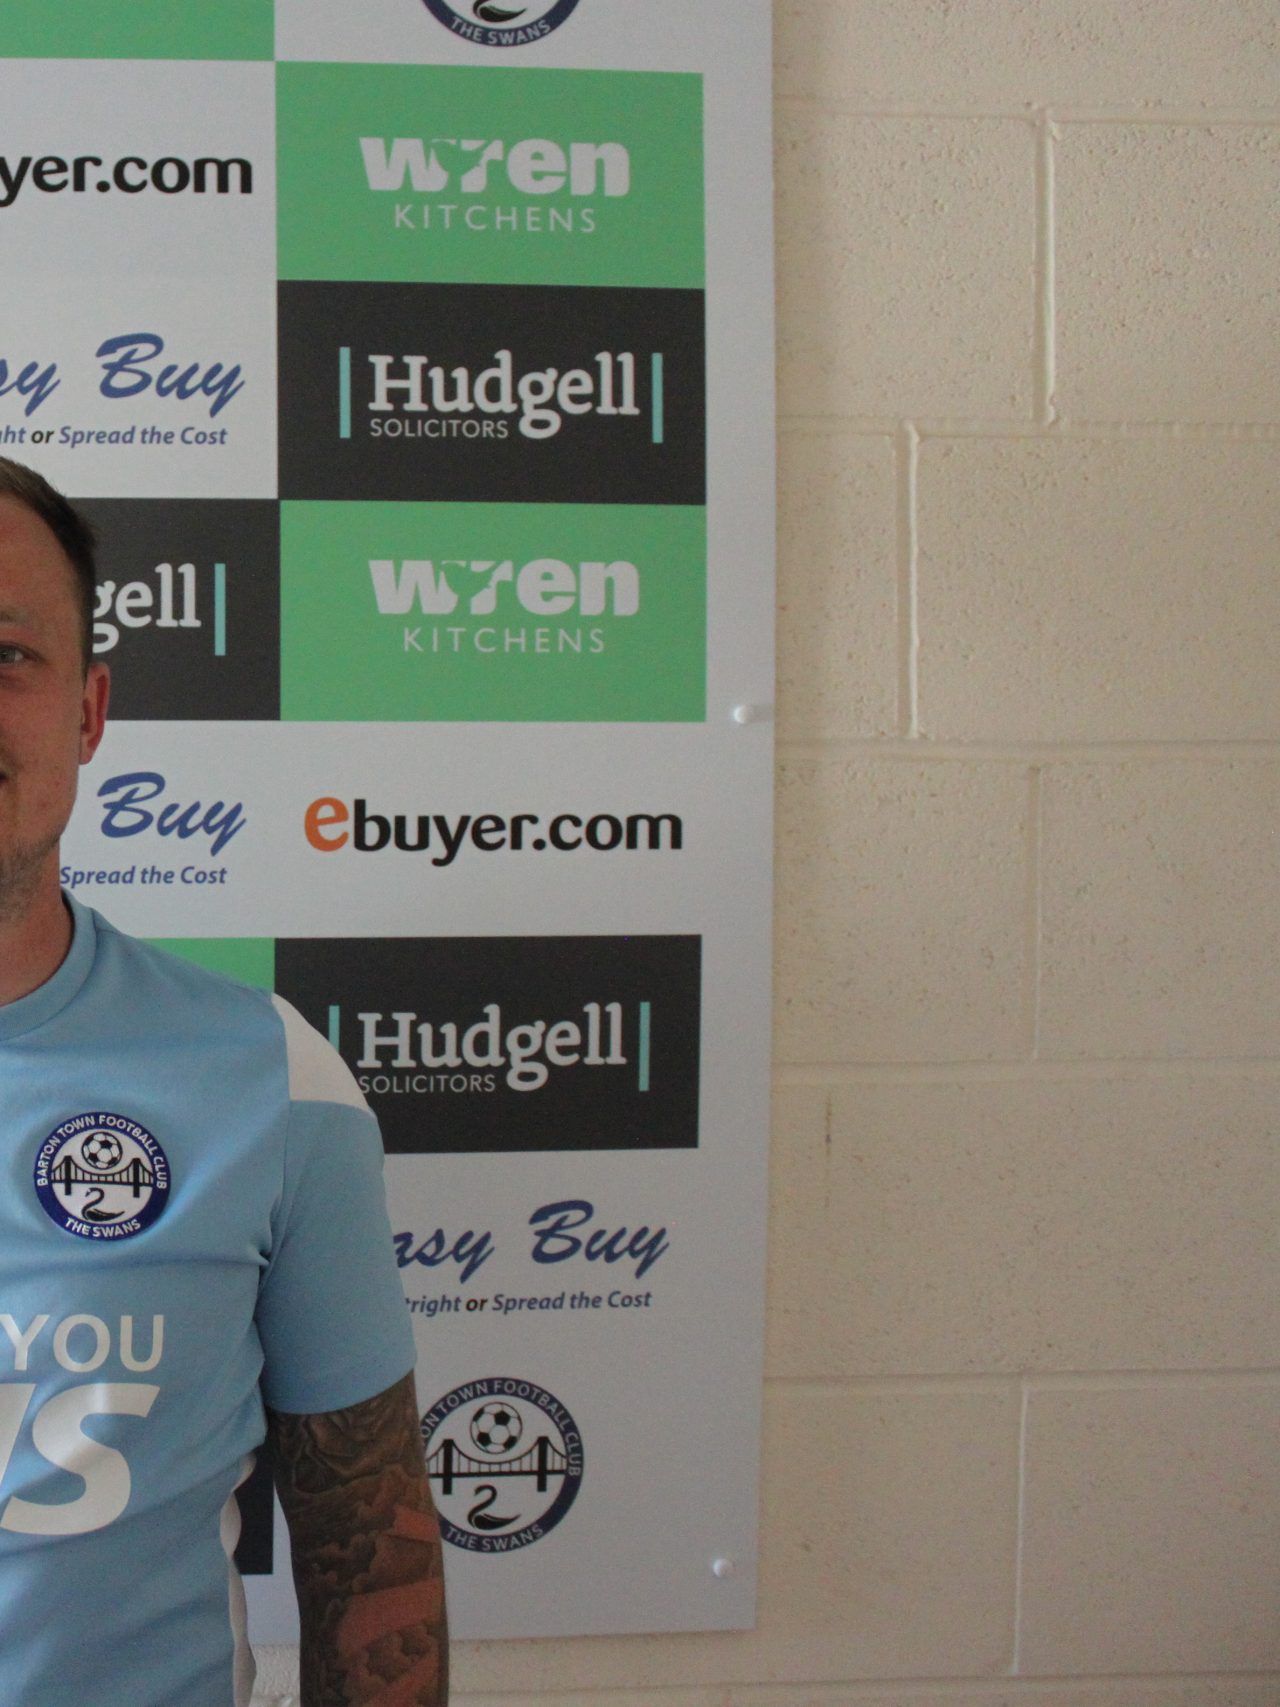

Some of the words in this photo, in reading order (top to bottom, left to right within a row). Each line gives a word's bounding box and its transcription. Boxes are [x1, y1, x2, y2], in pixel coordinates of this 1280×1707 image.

[450, 16, 483, 42] THE
[487, 18, 551, 46] SWANS
[359, 137, 630, 196] wren
[393, 203, 596, 234] KITCHENS
[96, 333, 245, 418] Buy
[368, 349, 640, 439] Hudgell
[30, 430, 55, 445] or
[58, 425, 137, 449] Spread
[140, 425, 176, 445] the
[179, 426, 228, 446] Cost
[369, 417, 509, 439] SOLICITORS
[92, 563, 202, 654] gell
[369, 559, 639, 616] wren
[403, 626, 605, 654] KITCHENS
[97, 772, 246, 856] Buy
[304, 796, 683, 868] ebuyer.com
[59, 865, 137, 889] Spread
[140, 865, 176, 885] the
[180, 865, 228, 885] Cost
[357, 1002, 627, 1092] Hudgell
[359, 1073, 497, 1095] SOLICITORS
[37, 1136, 61, 1187] BARTON
[58, 1115, 96, 1138] TOWN
[98, 1114, 158, 1156] FOOTBALL
[152, 1156, 167, 1190] CLUB
[65, 1217, 90, 1236] THE
[93, 1218, 141, 1238] SWANS
[529, 1200, 669, 1279] Buy
[405, 1293, 463, 1318] right
[465, 1298, 489, 1313] or
[491, 1291, 566, 1316] Spread
[569, 1290, 603, 1310] the
[606, 1290, 653, 1309] Cost
[437, 1382, 490, 1415] TOWN
[493, 1379, 572, 1433] FOOTBALL
[565, 1431, 582, 1477] CLUB
[446, 1526, 479, 1549] THE
[482, 1524, 545, 1551] SWANS
